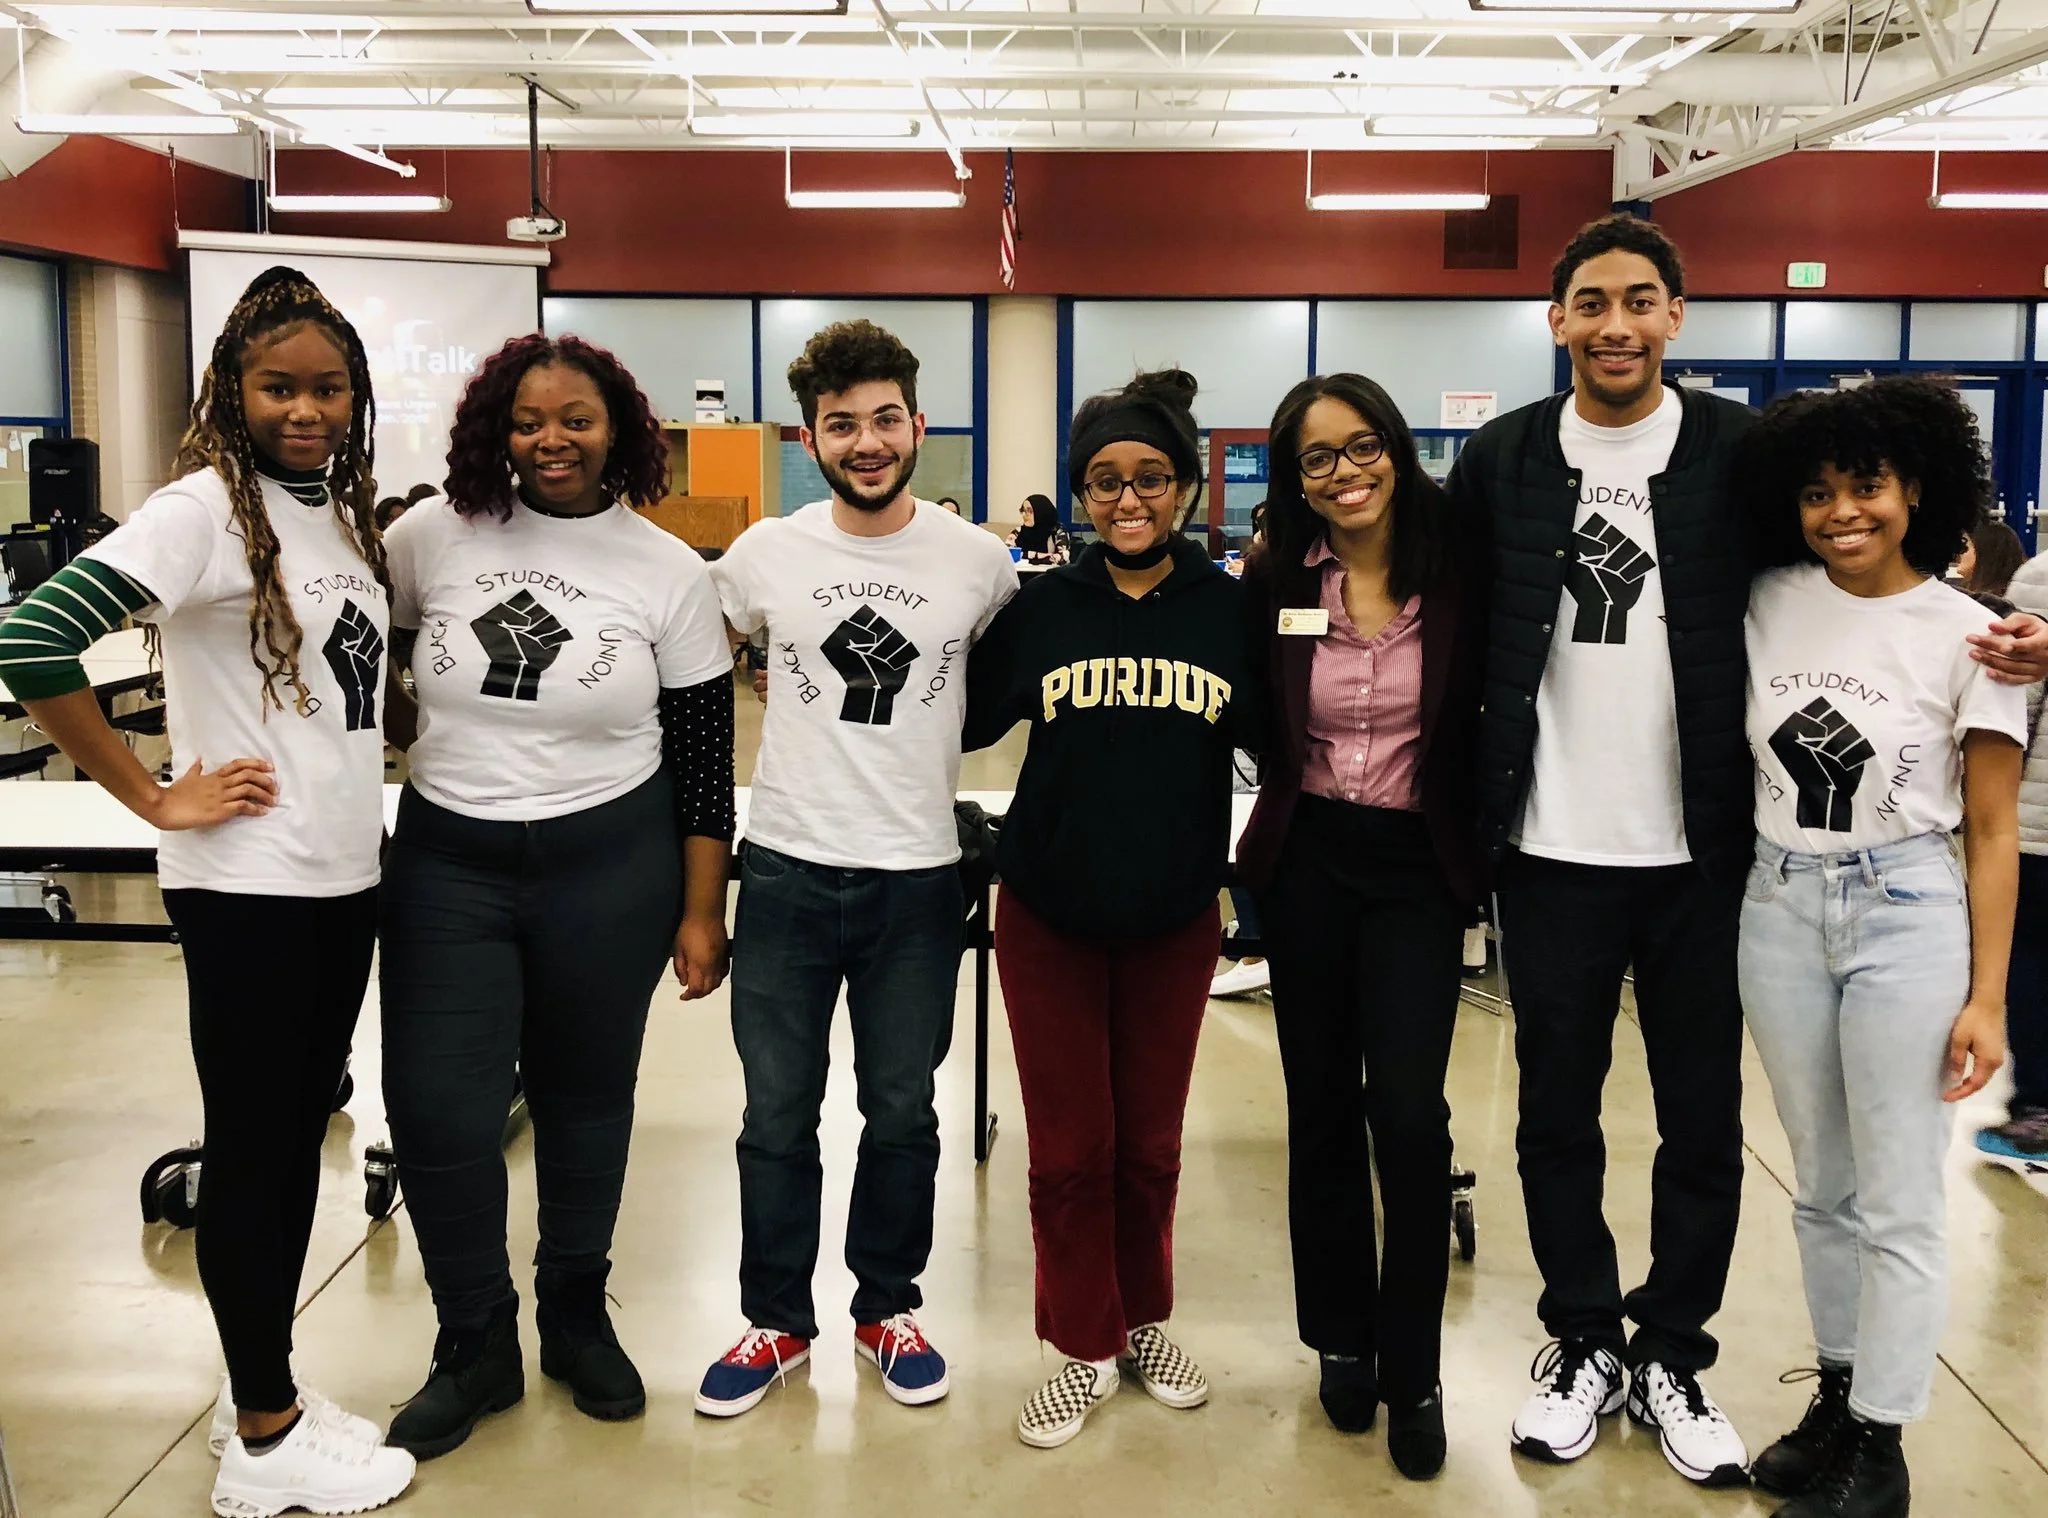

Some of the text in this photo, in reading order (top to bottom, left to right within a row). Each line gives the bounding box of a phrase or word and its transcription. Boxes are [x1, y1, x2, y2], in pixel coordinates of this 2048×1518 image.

[1794, 264, 1822, 285] EXIT
[304, 573, 380, 604] STUDENT
[475, 569, 587, 604] STUDENT
[812, 582, 929, 610] STUDENT
[430, 619, 457, 676] BLACK
[577, 627, 621, 690] UNION
[779, 640, 822, 705] BLACK
[920, 638, 961, 708] UNION
[1041, 657, 1232, 724] PURDUE
[1769, 672, 1889, 707] STUDENT
[1875, 744, 1921, 822] UNION
